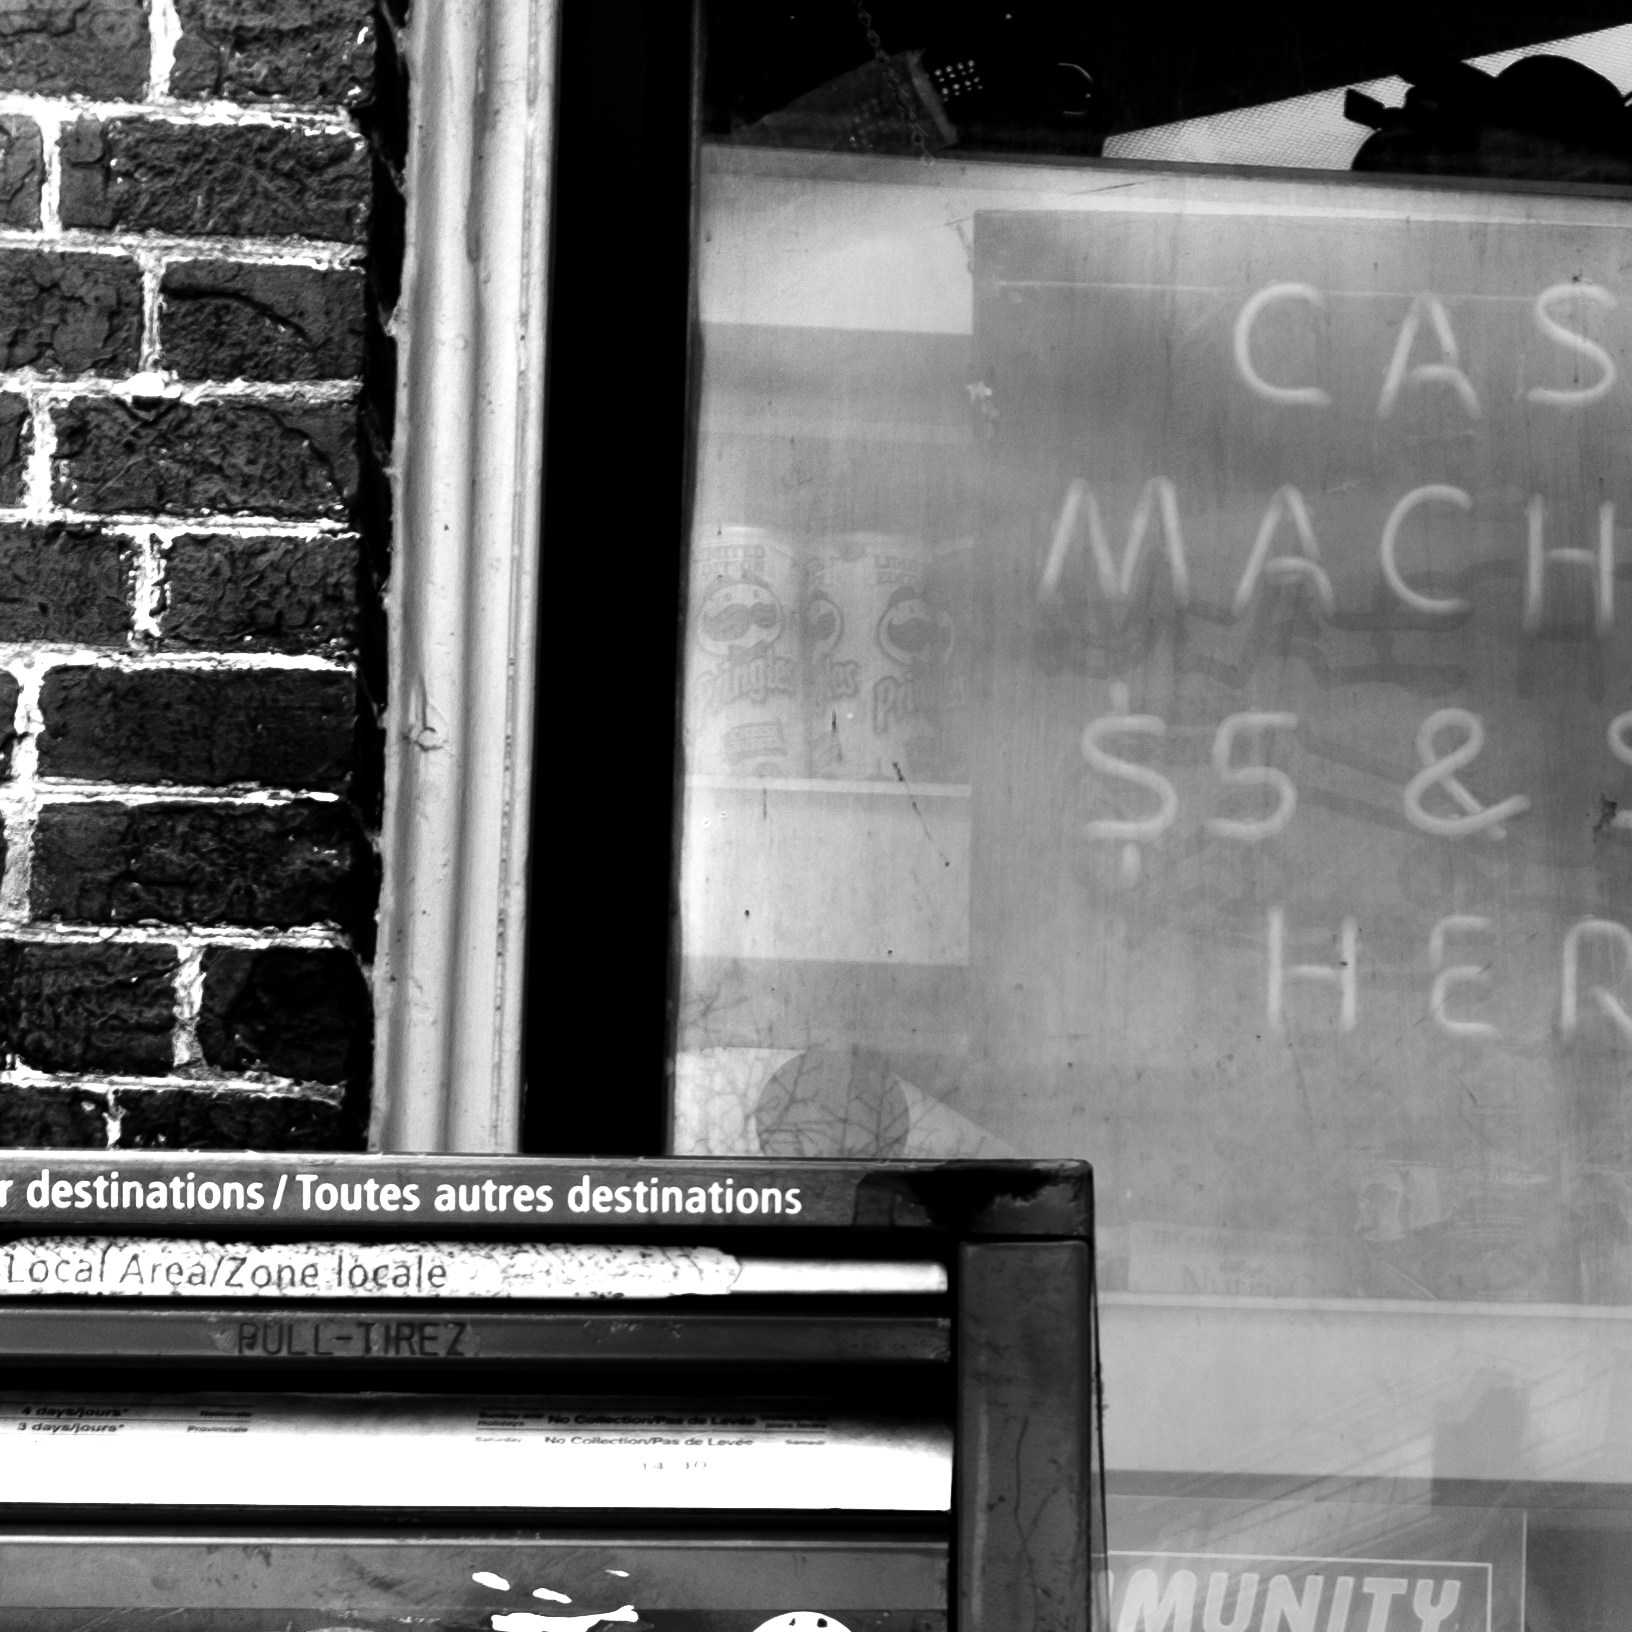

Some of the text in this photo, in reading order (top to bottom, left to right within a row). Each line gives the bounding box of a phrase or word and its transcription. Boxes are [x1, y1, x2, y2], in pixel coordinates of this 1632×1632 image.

[1082, 679, 1300, 890] $5
[1401, 706, 1531, 840] &
[27, 1168, 265, 1210] destinations
[295, 1174, 421, 1212] Toutes
[434, 1179, 554, 1213] autres
[567, 1174, 803, 1214] destinations
[6, 1244, 448, 1290] Local Area/Zone locale
[237, 1321, 466, 1357] PULL-TIREZ
